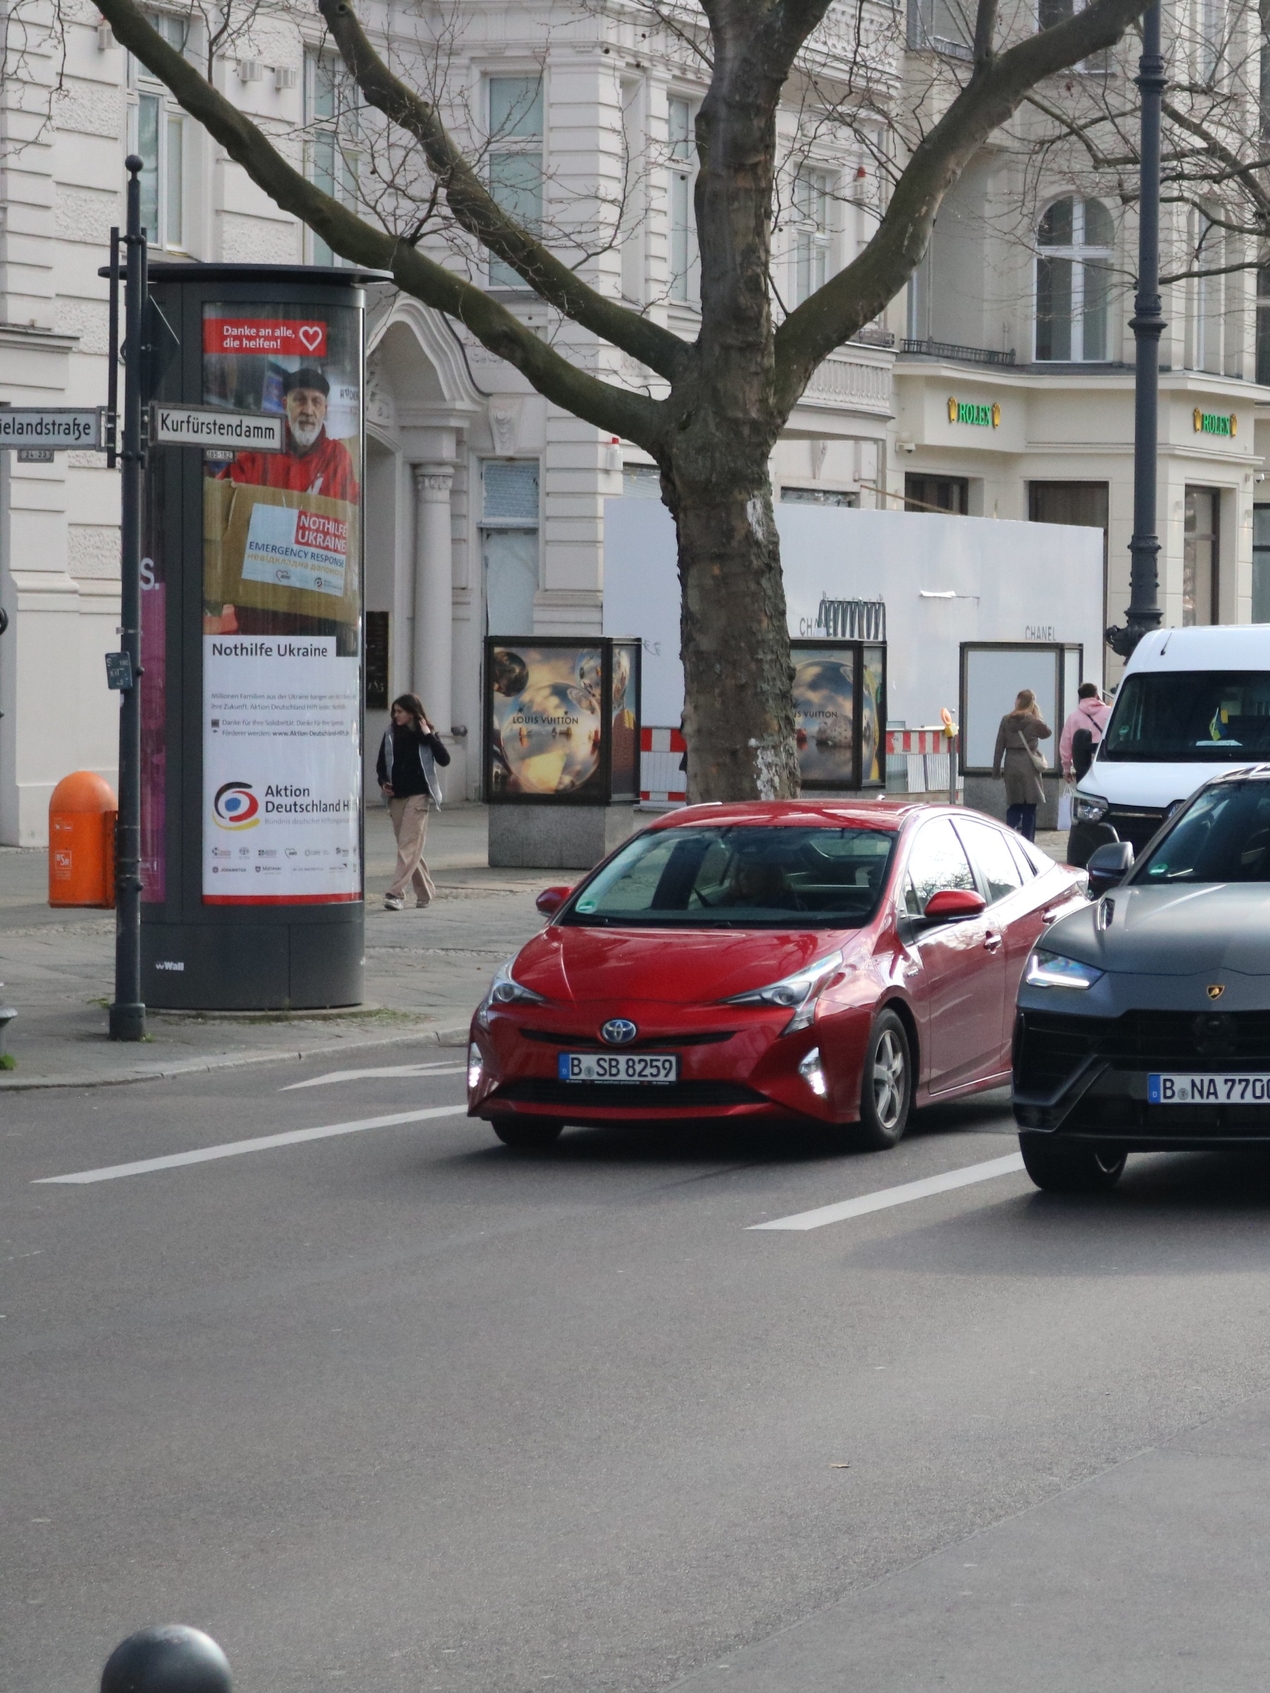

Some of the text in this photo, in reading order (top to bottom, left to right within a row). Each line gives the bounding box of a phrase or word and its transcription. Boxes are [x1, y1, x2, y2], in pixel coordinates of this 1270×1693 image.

[223, 326, 295, 338] Danke an alle,
[223, 338, 281, 349] die helfen!
[958, 402, 991, 426] ROLEX
[1202, 413, 1230, 436] ROLEX
[161, 413, 275, 440] Kurfürstendamm
[300, 515, 348, 538] NOTHILFE
[298, 530, 347, 552] UKRAINE
[249, 541, 345, 568] EMERGENCY RESPONSE
[1025, 625, 1057, 641] CHANEL
[212, 643, 328, 658] Nothilfe Ukraine
[512, 716, 579, 725] LOUIS VUITTON
[265, 785, 310, 798] Aktion
[265, 800, 341, 813] Deutschland
[570, 1057, 673, 1078] B SB 8259
[1162, 1078, 1176, 1100] B
[1191, 1078, 1219, 1100] NA
